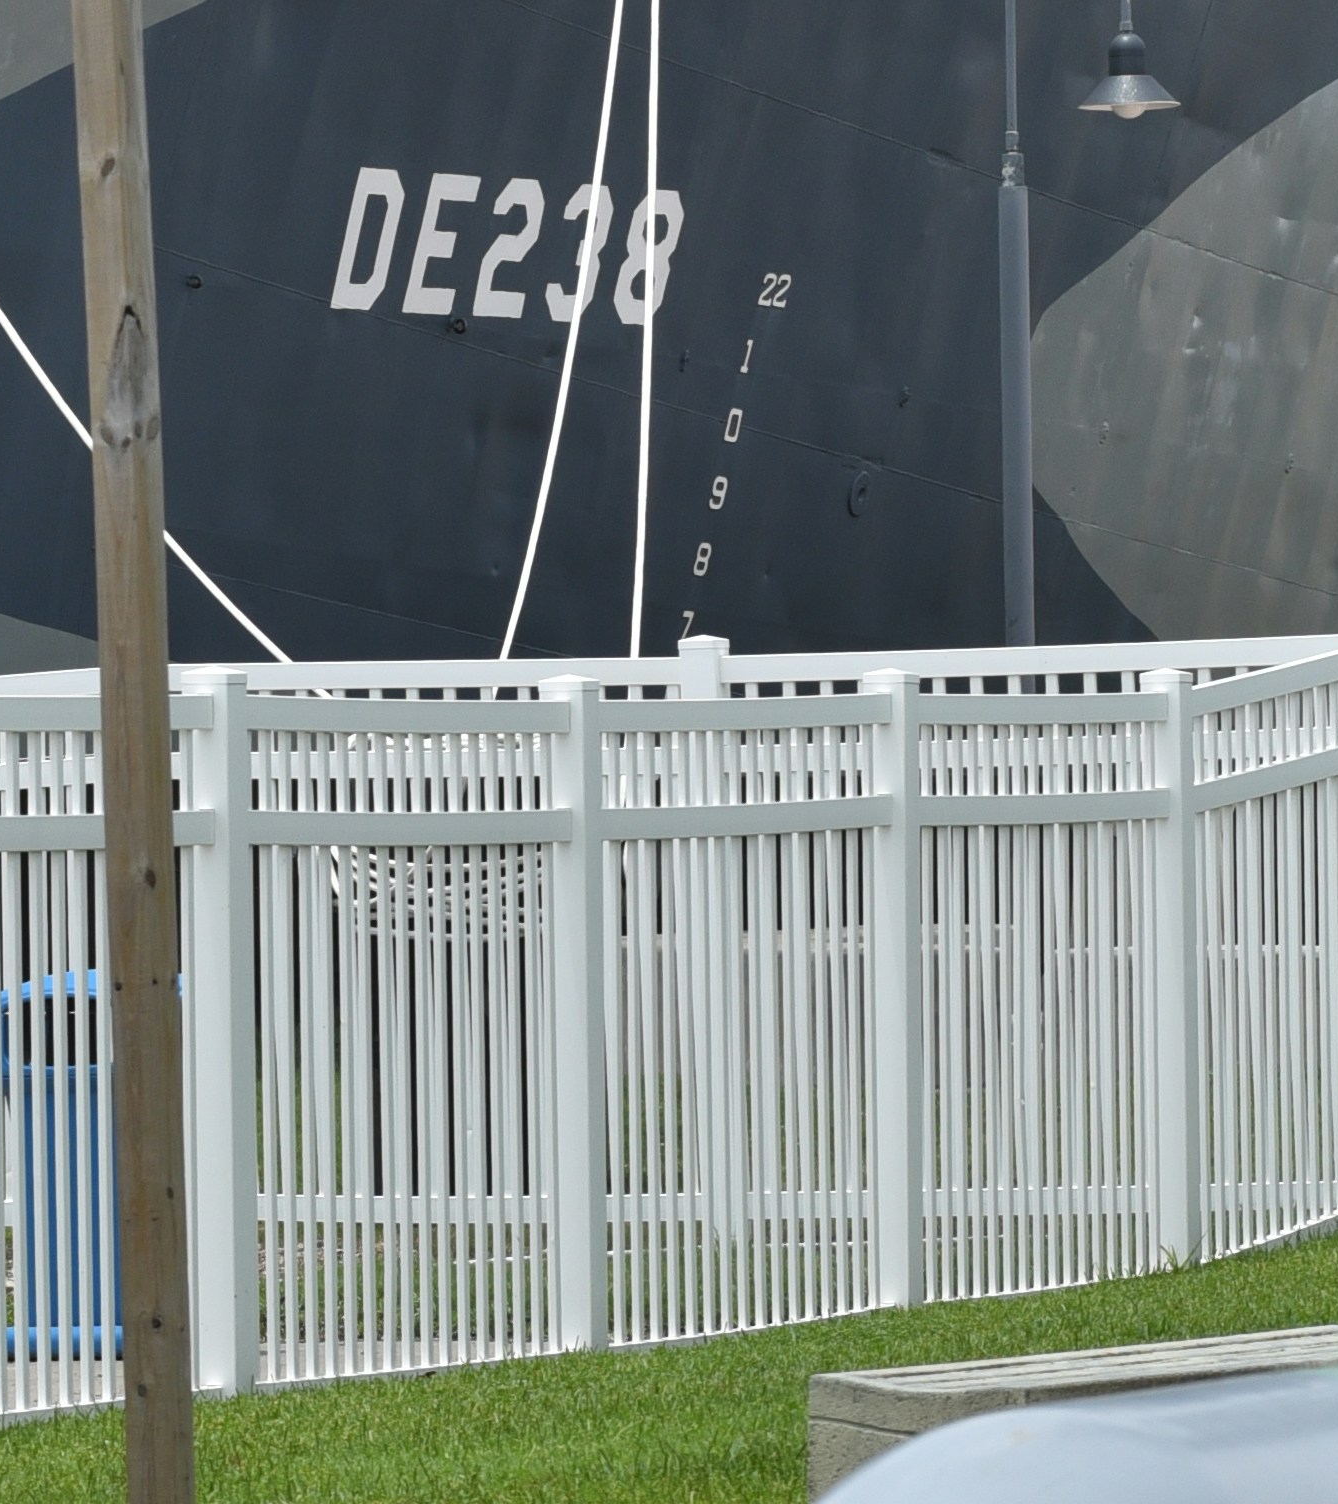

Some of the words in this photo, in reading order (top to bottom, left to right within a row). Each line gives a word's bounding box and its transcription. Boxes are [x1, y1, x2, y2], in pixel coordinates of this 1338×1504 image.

[330, 166, 685, 325] DE238
[758, 273, 791, 307] 22
[740, 340, 753, 373] 1
[724, 408, 742, 442] 0
[709, 476, 727, 509] 9
[694, 543, 711, 576] 8
[682, 611, 694, 638] 7
